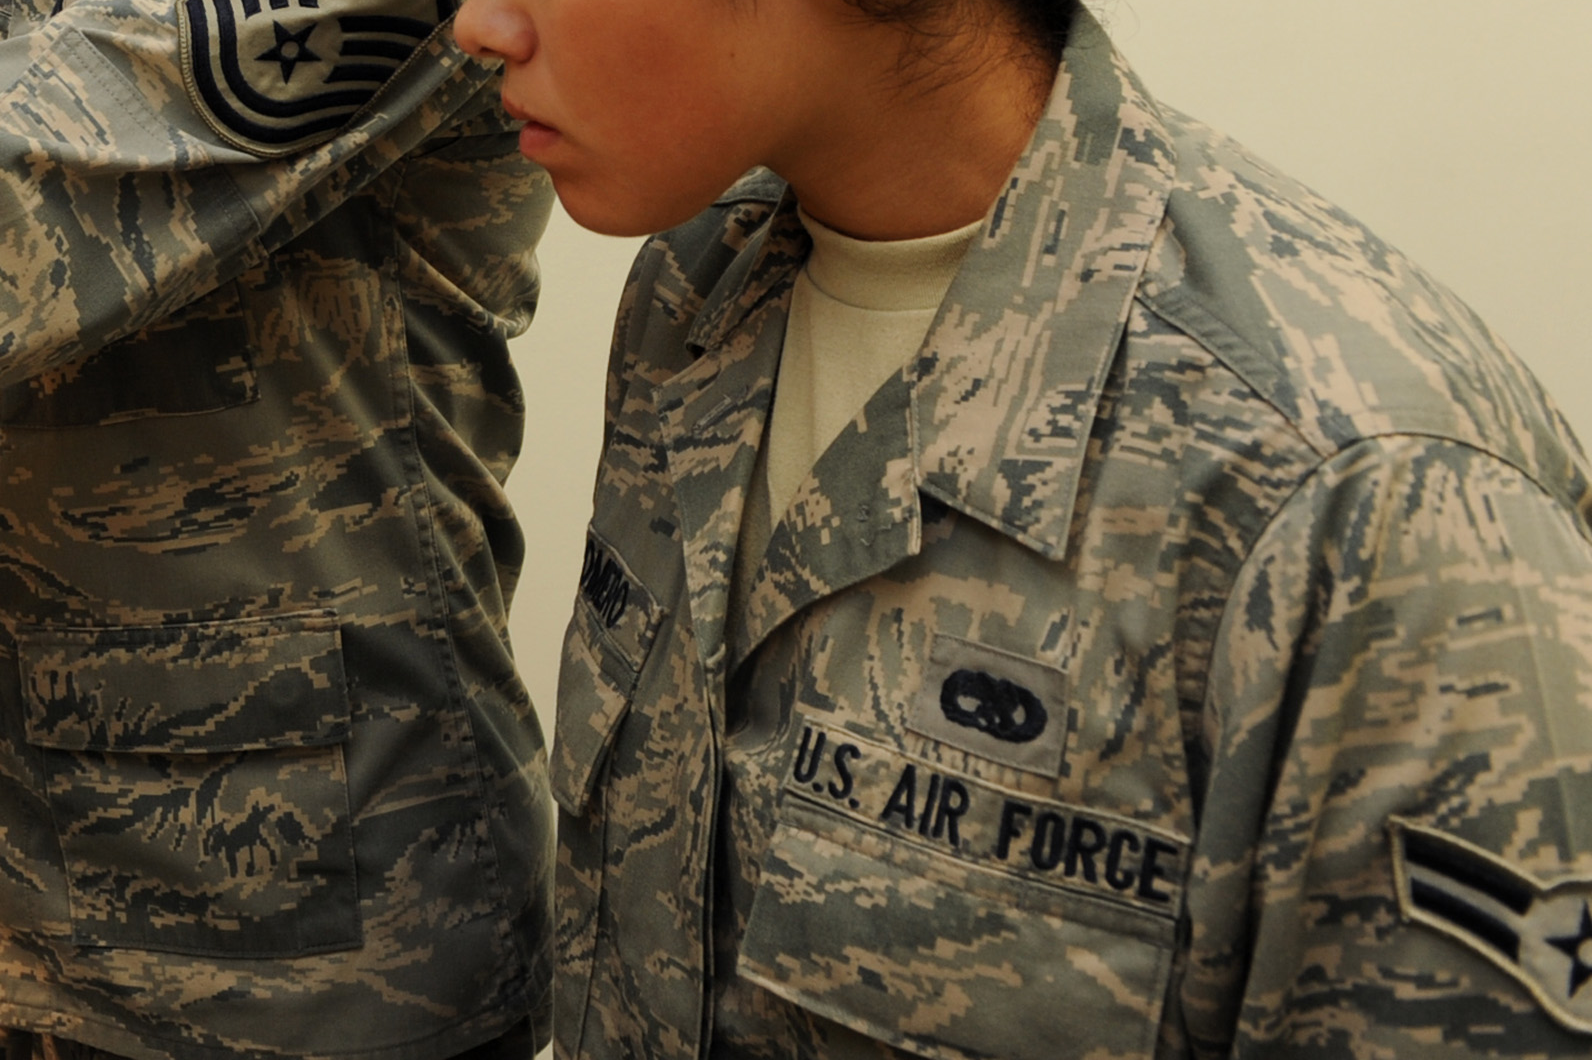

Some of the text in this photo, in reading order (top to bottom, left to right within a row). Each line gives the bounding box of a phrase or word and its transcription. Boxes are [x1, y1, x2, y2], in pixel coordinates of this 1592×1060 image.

[793, 726, 1178, 903] U.S. AIR FORCE
